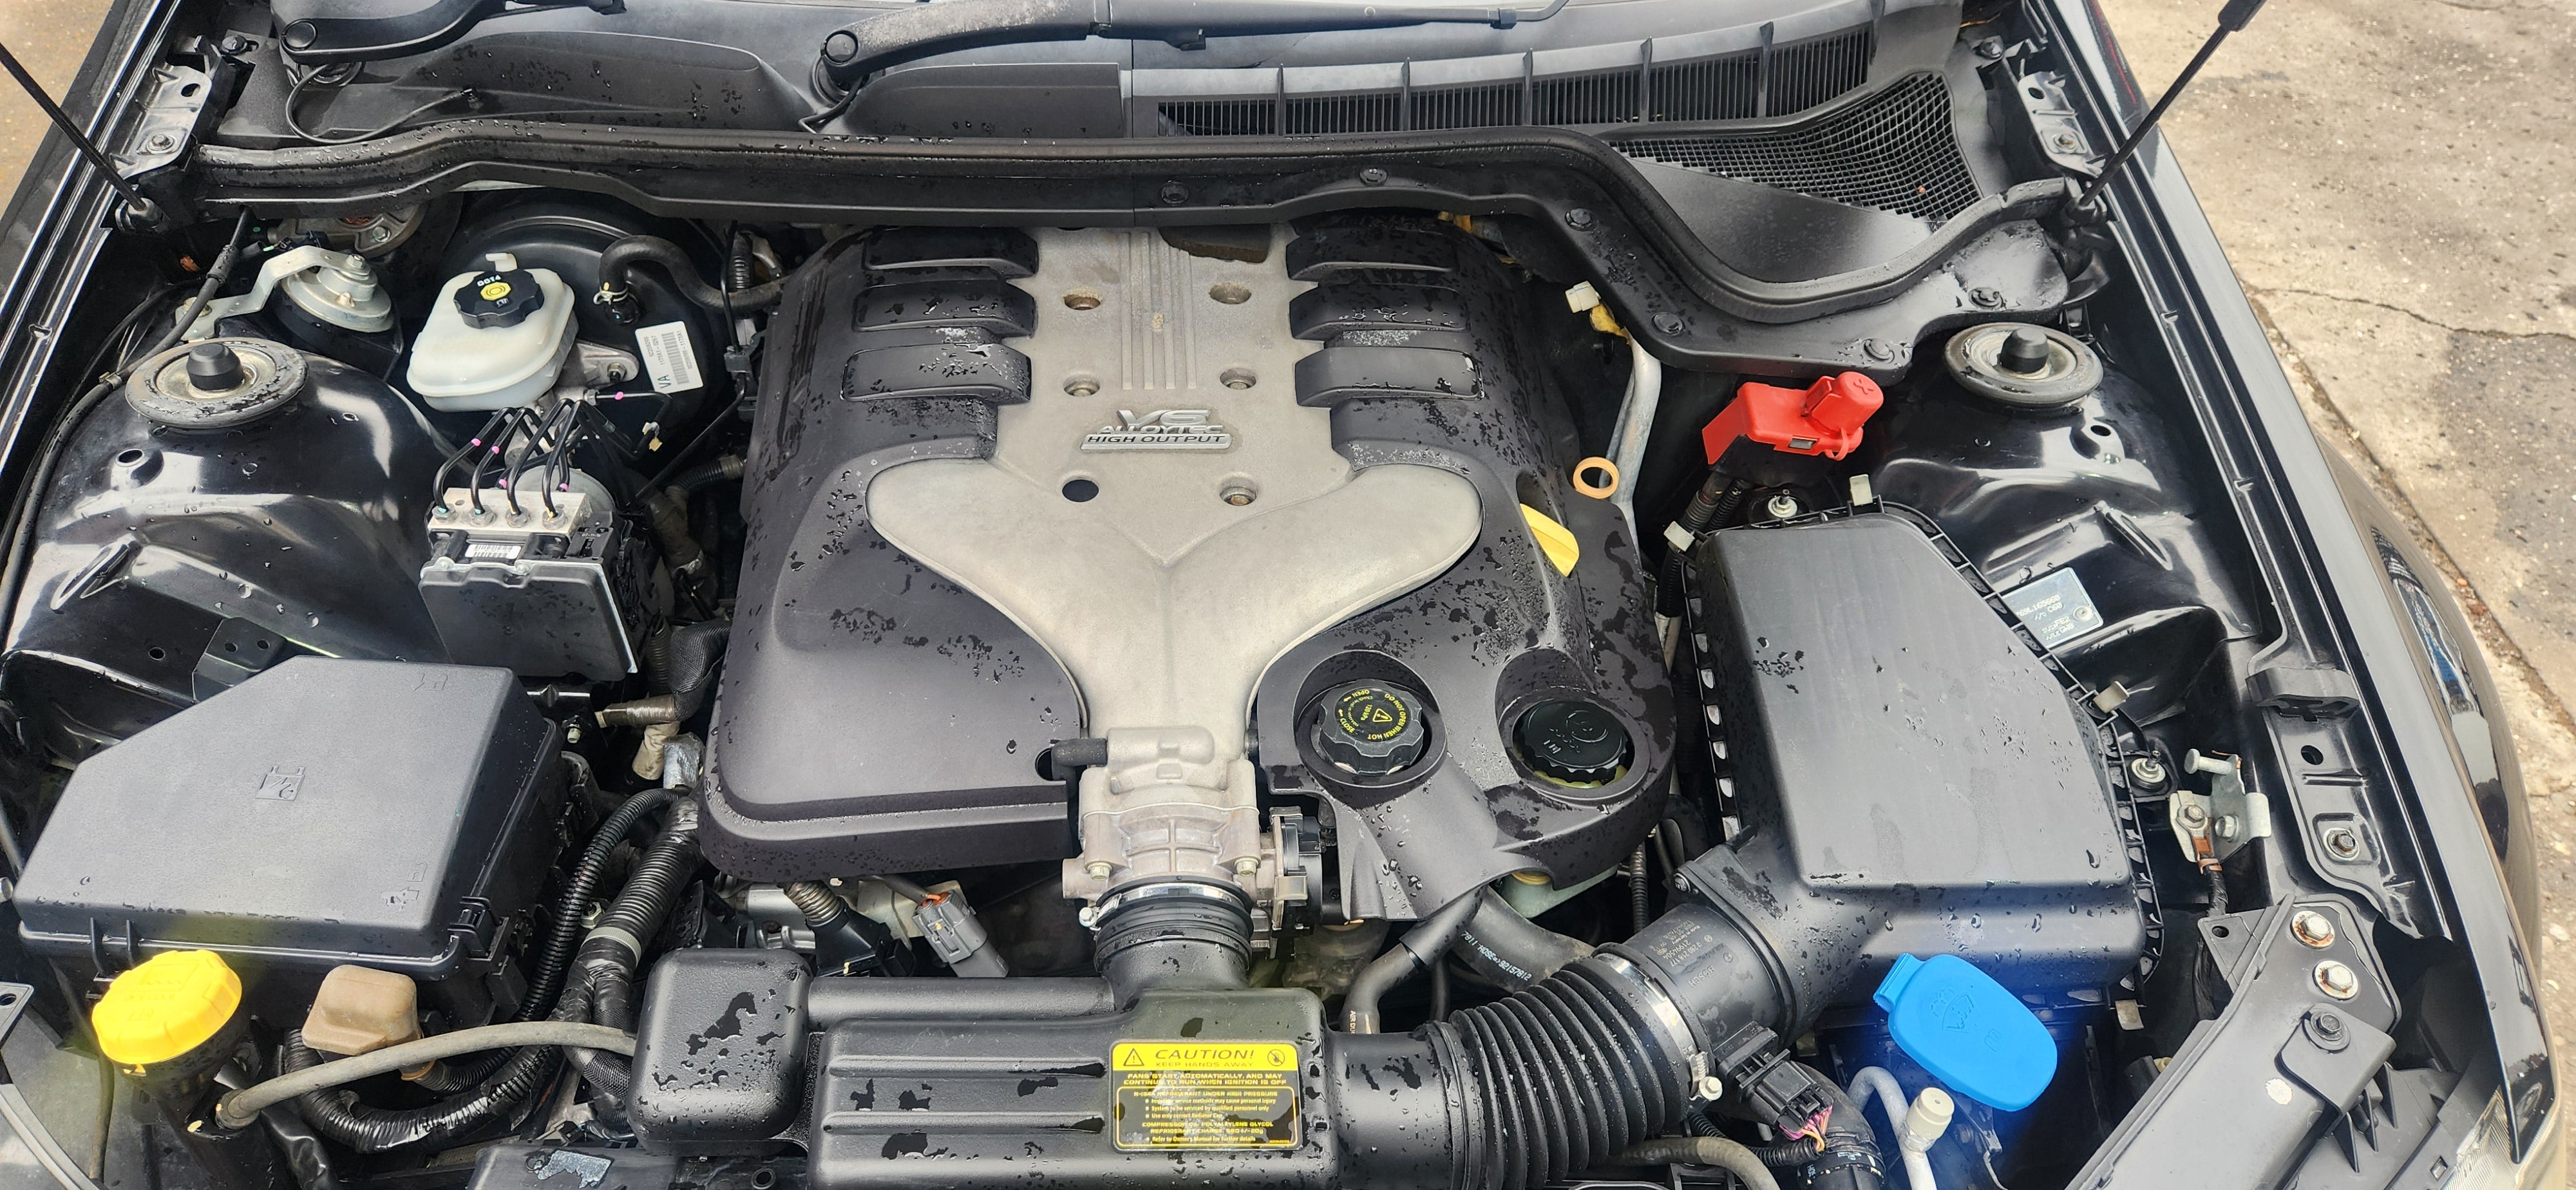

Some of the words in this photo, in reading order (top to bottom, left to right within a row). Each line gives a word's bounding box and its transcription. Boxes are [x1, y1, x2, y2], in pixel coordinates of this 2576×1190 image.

[658, 374, 671, 388] VA
[1117, 410, 1211, 428] V6
[1096, 425, 1223, 434] ALLOYTEC
[2048, 601, 2063, 612] C60
[1352, 689, 1370, 697] OPEN
[1393, 700, 1405, 711] NOT
[1340, 718, 1355, 733] CLOSE
[1383, 725, 1402, 738] WHEN
[1688, 965, 1716, 988] BOSCH
[1155, 1050, 1255, 1059] CAUTION!
